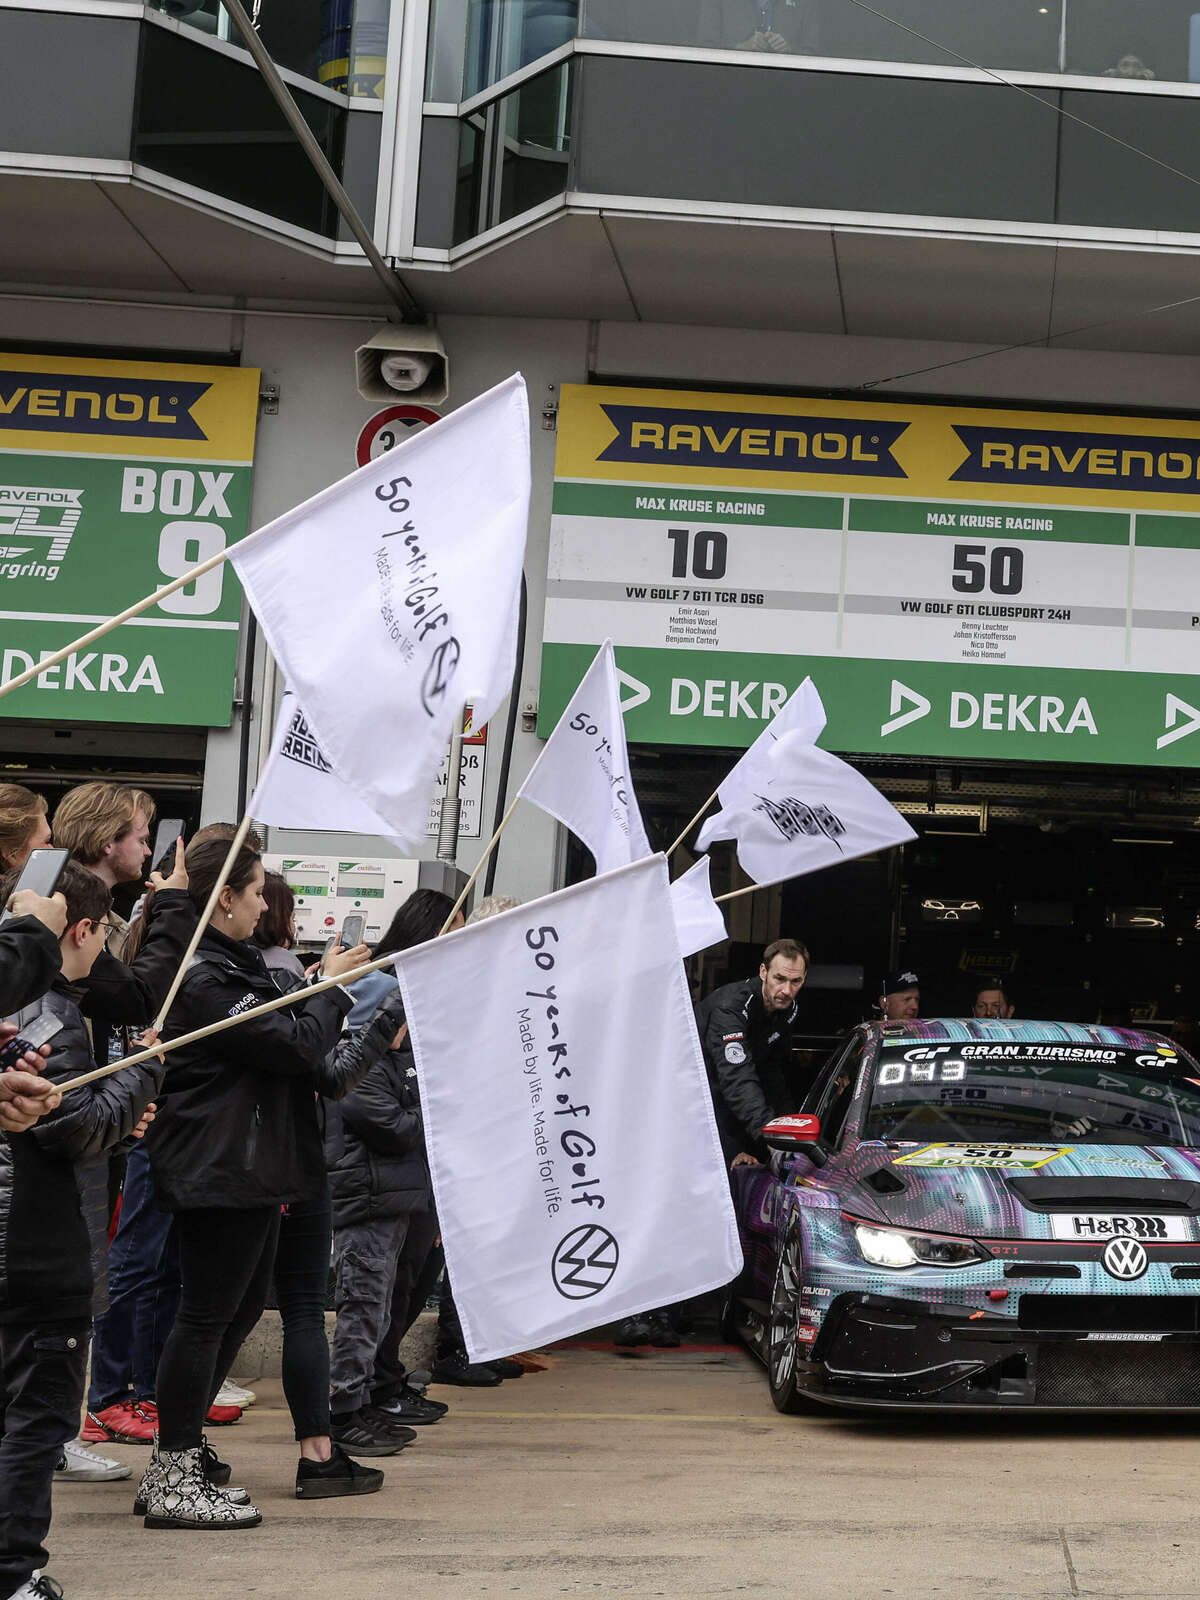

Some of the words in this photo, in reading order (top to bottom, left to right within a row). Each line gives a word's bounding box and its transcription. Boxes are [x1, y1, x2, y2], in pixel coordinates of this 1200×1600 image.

[630, 421, 879, 462] RAVENOL
[120, 466, 234, 518] BOX
[375, 476, 413, 513] 50
[635, 496, 666, 512] MAX
[669, 498, 713, 515] KRUSE
[718, 500, 766, 517] RACING
[926, 512, 957, 528] MAX
[961, 514, 1003, 530] KRUSE
[1008, 516, 1054, 532] RACING
[667, 528, 728, 580] 10
[157, 521, 227, 615] 9
[952, 543, 1024, 596] 50
[625, 586, 648, 599] VW
[650, 588, 680, 600] GOLF
[682, 590, 690, 601] 7
[693, 590, 712, 602] GTI
[714, 591, 737, 603] TCR
[741, 593, 765, 604] DSG
[669, 616, 697, 625] Matthias
[900, 600, 922, 614] VW
[926, 602, 954, 615] GOLF
[956, 604, 975, 616] GTI
[978, 605, 1045, 619] CLUBSPORT
[1047, 608, 1072, 622] 24H
[665, 634, 695, 645] Benjamin
[669, 625, 684, 633] Timo
[2, 649, 165, 694] DEKRA
[570, 712, 598, 736] 50
[949, 691, 1099, 735] DEKRA
[525, 925, 559, 972] 50
[516, 1007, 537, 1056] Made
[525, 984, 572, 1080] years
[960, 1045, 1020, 1056] GRAN
[1025, 1046, 1117, 1061] TURISMO
[1058, 1056, 1117, 1064] SIMULATOR
[522, 1054, 539, 1078] by
[528, 1077, 541, 1111] life.
[553, 1093, 592, 1119] of
[533, 1110, 548, 1159] Made
[942, 1158, 1025, 1168] DEKRA
[963, 1147, 1013, 1159] 50
[540, 1159, 554, 1184] for
[560, 1128, 606, 1212] Golf
[543, 1185, 560, 1219] life.
[1073, 1216, 1132, 1236] H&R
[990, 1246, 1019, 1255] GTI
